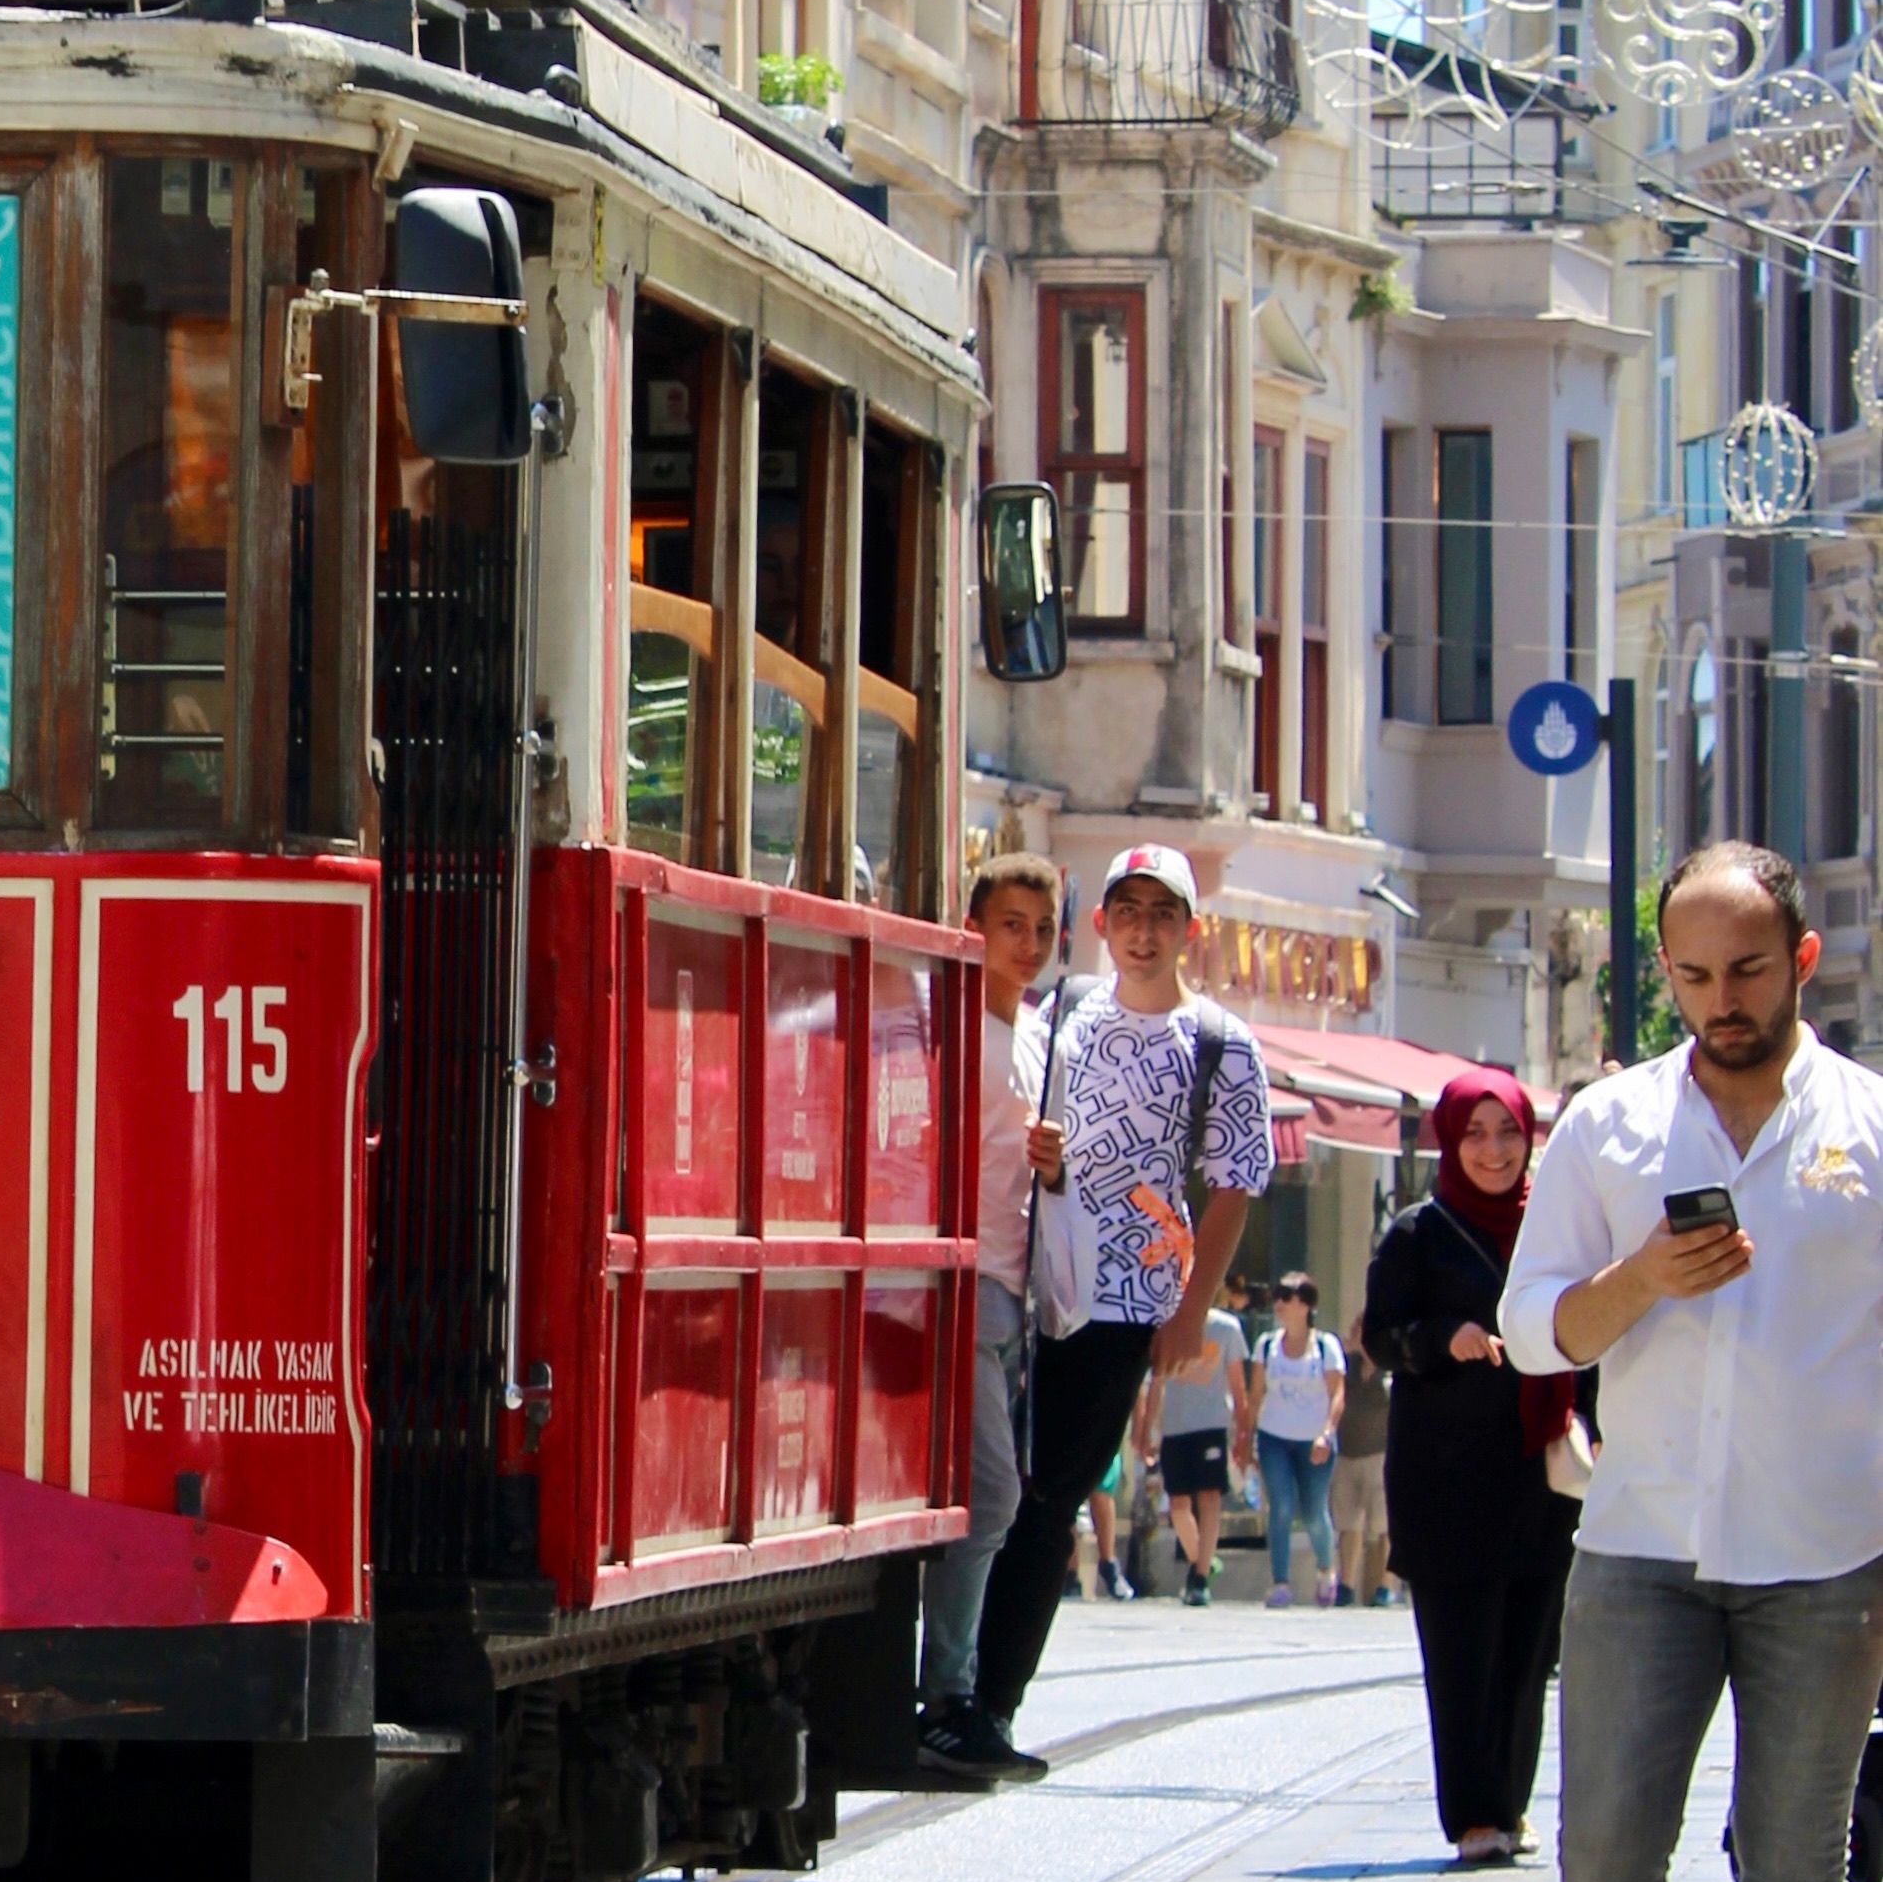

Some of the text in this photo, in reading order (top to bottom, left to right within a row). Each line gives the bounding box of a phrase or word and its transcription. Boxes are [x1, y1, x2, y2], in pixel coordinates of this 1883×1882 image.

[173, 985, 288, 1093] 115
[139, 1339, 334, 1381] ASILMAK YASAK
[123, 1388, 337, 1434] VE TEHLİKELİDİR
